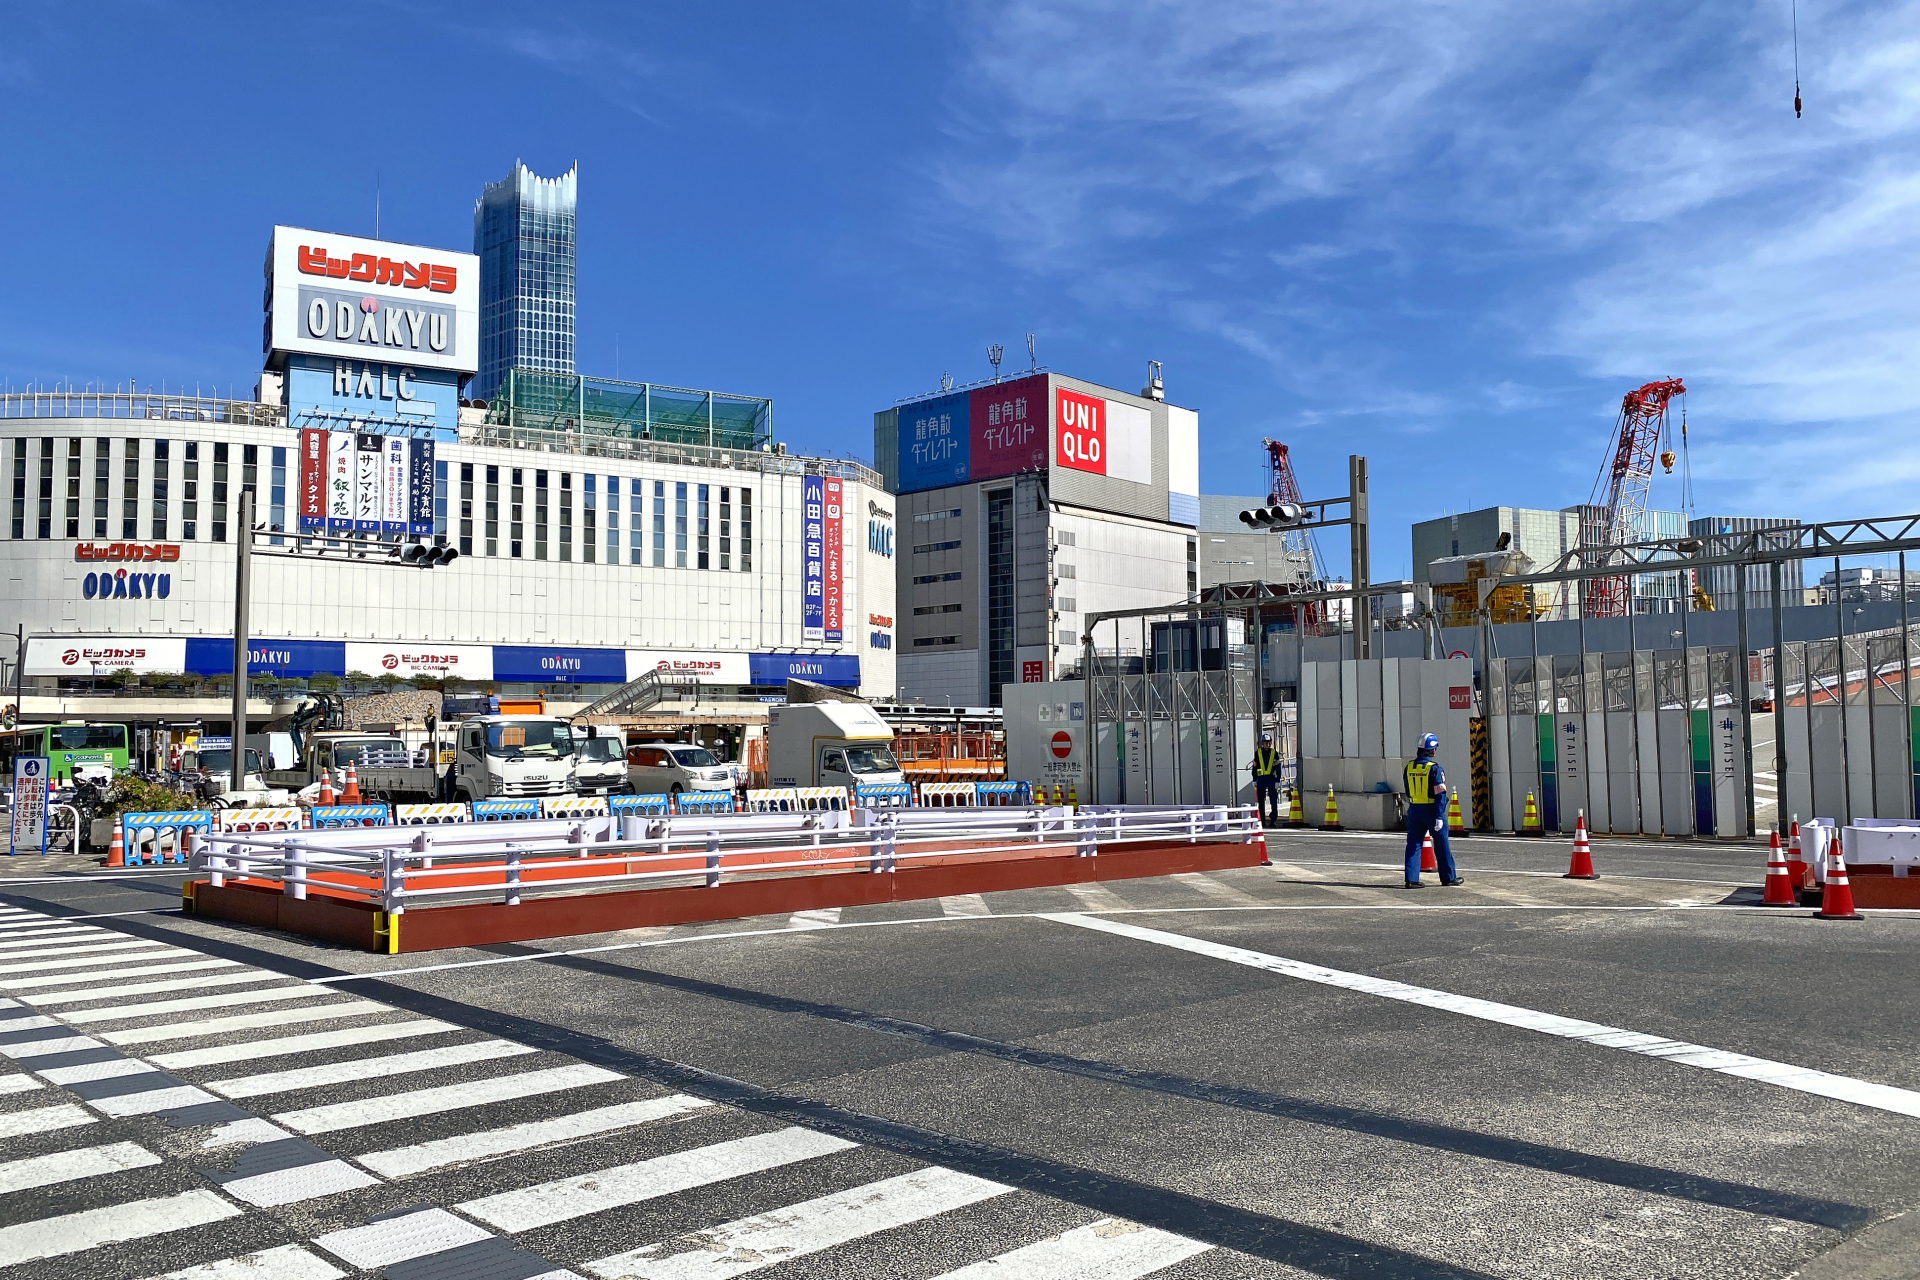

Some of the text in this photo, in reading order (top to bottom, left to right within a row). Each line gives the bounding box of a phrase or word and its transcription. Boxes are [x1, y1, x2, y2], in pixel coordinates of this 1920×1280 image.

[298, 245, 457, 294] ビックカメラ
[308, 297, 448, 352] ODAKYU
[333, 360, 416, 400] HALC
[916, 413, 951, 441] 龍角散
[989, 397, 1027, 426] 龍角散
[1063, 399, 1096, 432] UNI
[309, 433, 319, 459] 美容室
[391, 440, 402, 464] 歯科
[911, 439, 958, 464] ダイレクト
[983, 422, 1035, 450] ダイレクト
[1063, 431, 1099, 462] QLO
[338, 457, 346, 474] 焼肉
[420, 442, 431, 518] 新宿 なだ万賓館
[308, 485, 318, 513] タナカ
[333, 478, 350, 515] 叙々苑
[359, 455, 373, 517] サンマルク
[75, 542, 181, 562] ビックカメラ
[806, 485, 821, 596] 小田急百貨店
[869, 520, 893, 559] HALC
[83, 568, 170, 600] ODAKYU
[828, 550, 838, 628] たまる・つかえる
[83, 649, 146, 658] ビックカメラ
[402, 654, 458, 664] ビックカメラ
[541, 655, 580, 670] ODAKYU
[673, 660, 721, 669] ビックカメラ
[790, 661, 823, 674] ODAKYU
[1073, 707, 1082, 716] IN
[1450, 694, 1470, 703] OUT
[1043, 762, 1081, 772] 一般車両進入禁止
[1131, 740, 1139, 773] TAISEI
[1215, 740, 1223, 774] TAISEI
[1567, 737, 1577, 778] TAISEI
[1723, 734, 1734, 778] TAISEI
[14, 778, 24, 842] 通行してください
[22, 778, 31, 826] 押し歩きにて
[28, 778, 38, 834] 自転車は歩道を
[36, 778, 45, 821] これより先、
